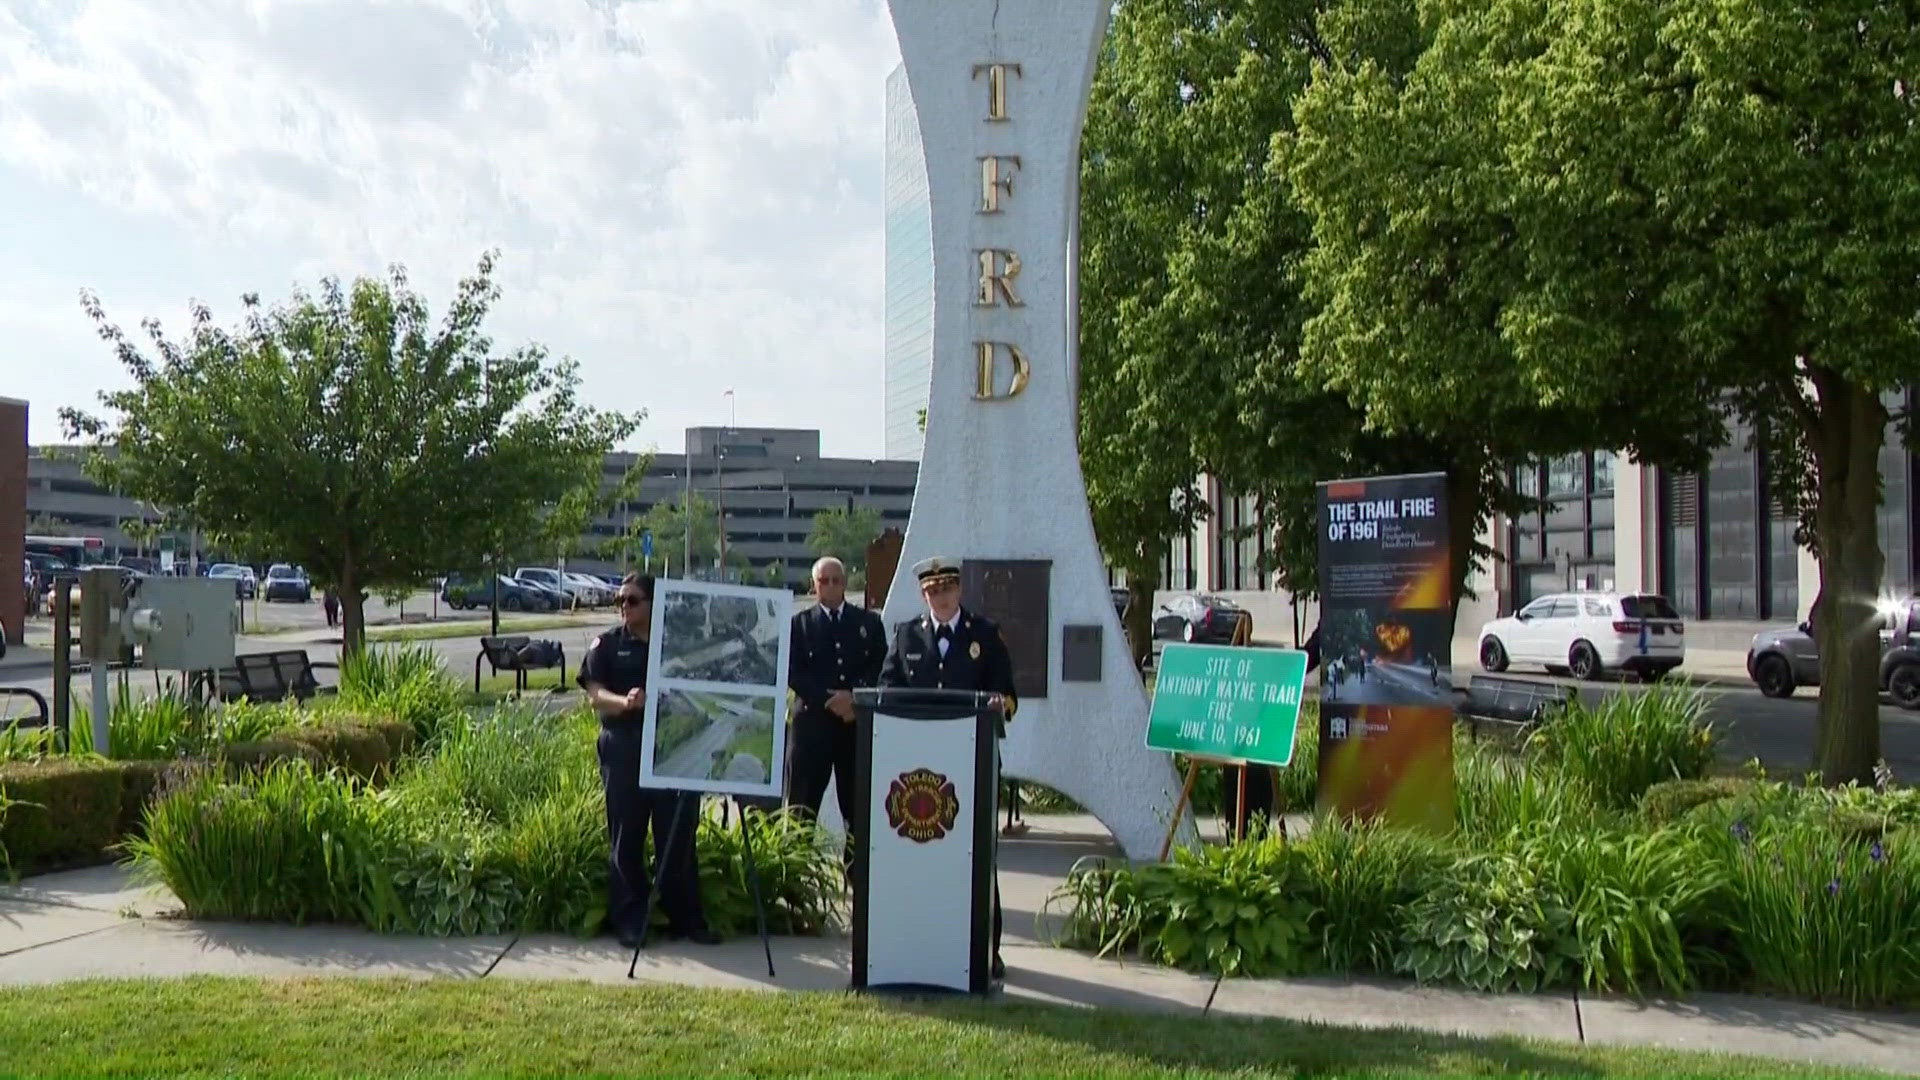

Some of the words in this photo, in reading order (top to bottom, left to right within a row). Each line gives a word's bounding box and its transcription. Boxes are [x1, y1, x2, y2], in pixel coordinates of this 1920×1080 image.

[972, 63, 1031, 401] TFRD
[1328, 502, 1355, 521] THE
[1357, 500, 1399, 520] TRAIL
[1401, 497, 1435, 518] FIRE
[1328, 522, 1347, 541] OF
[1349, 521, 1378, 540] 1961
[1206, 657, 1230, 677] SITE
[1237, 659, 1253, 679] OF
[1158, 675, 1211, 698] ANTHONY
[1216, 680, 1257, 701] WAYNE
[1262, 683, 1296, 705] TRAIL
[1207, 701, 1234, 721] FIRE
[1176, 720, 1206, 740] JUNE
[1211, 723, 1226, 745] 10,
[1234, 726, 1260, 746] 1961
[903, 772, 942, 786] TOLEDO
[908, 828, 935, 839] OHIO
